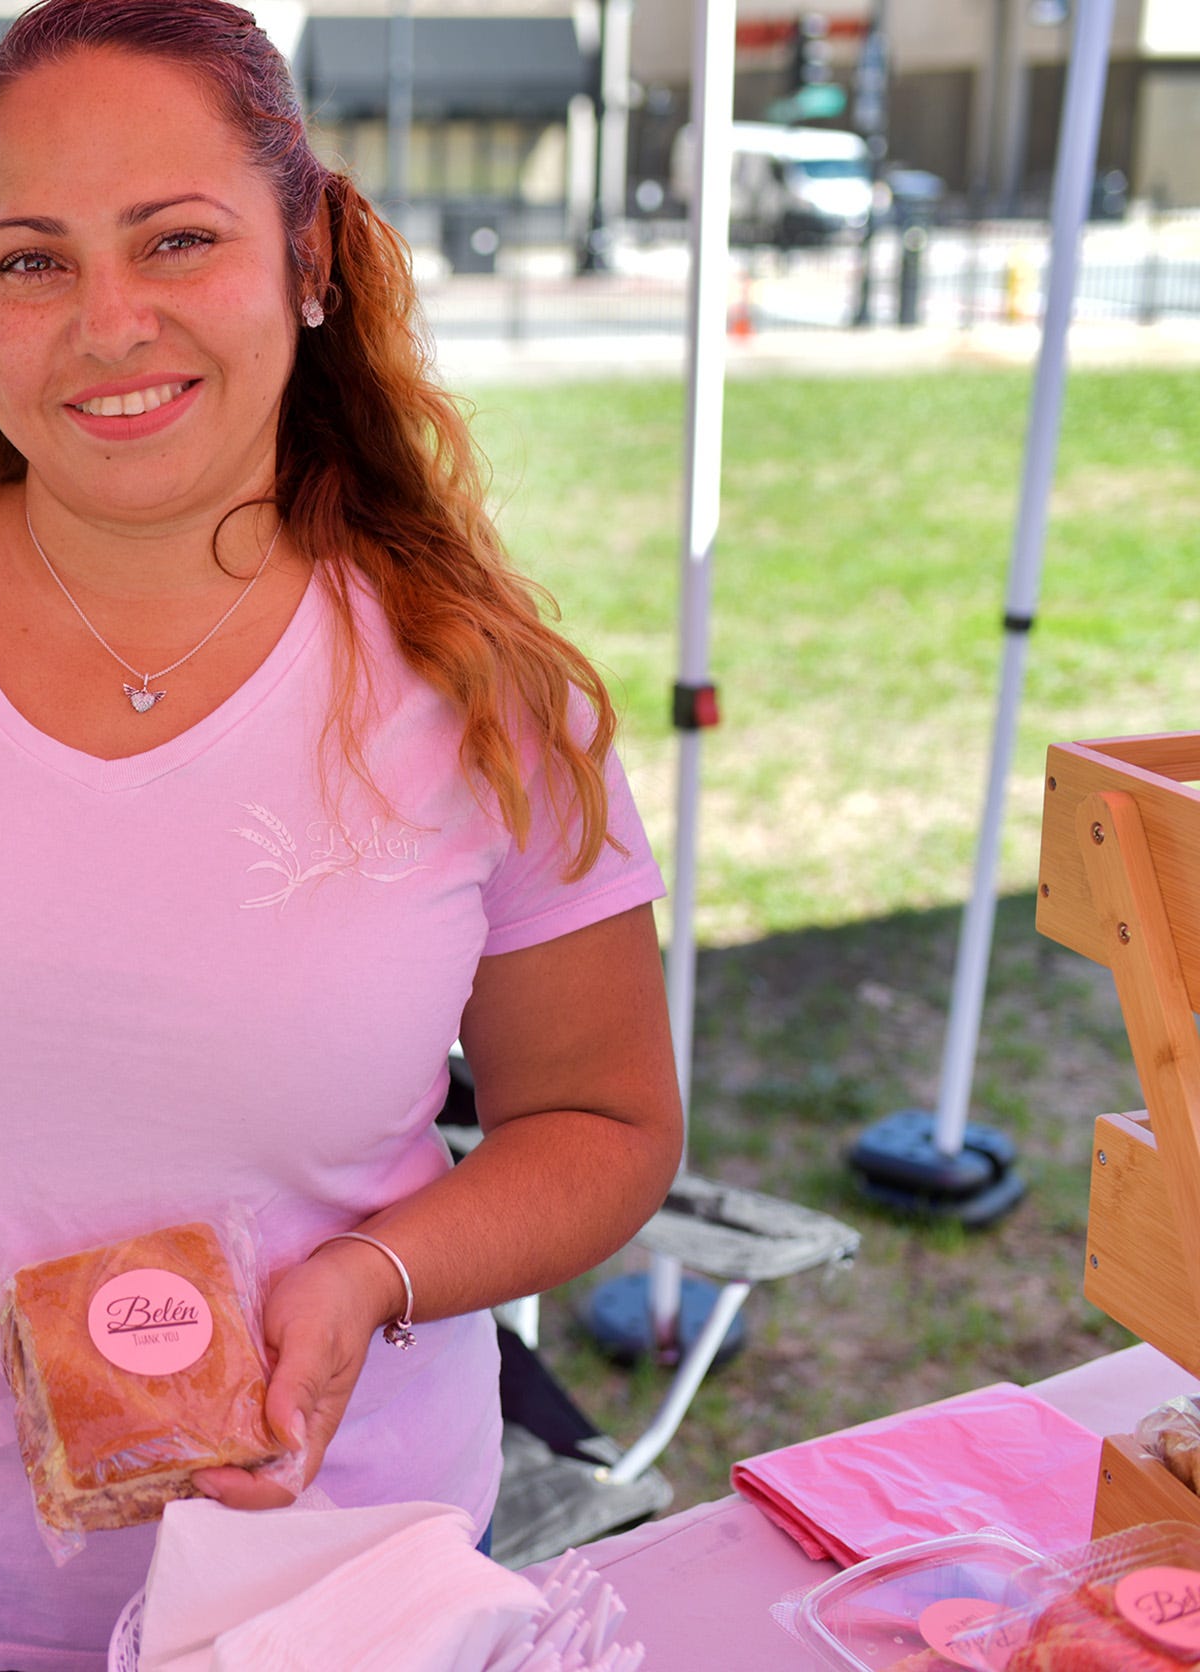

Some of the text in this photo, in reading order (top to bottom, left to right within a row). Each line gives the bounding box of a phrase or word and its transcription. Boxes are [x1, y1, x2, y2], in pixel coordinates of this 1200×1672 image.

[306, 816, 420, 861] Belén
[106, 1296, 199, 1332] Belén
[1134, 1585, 1200, 1625] Bel
